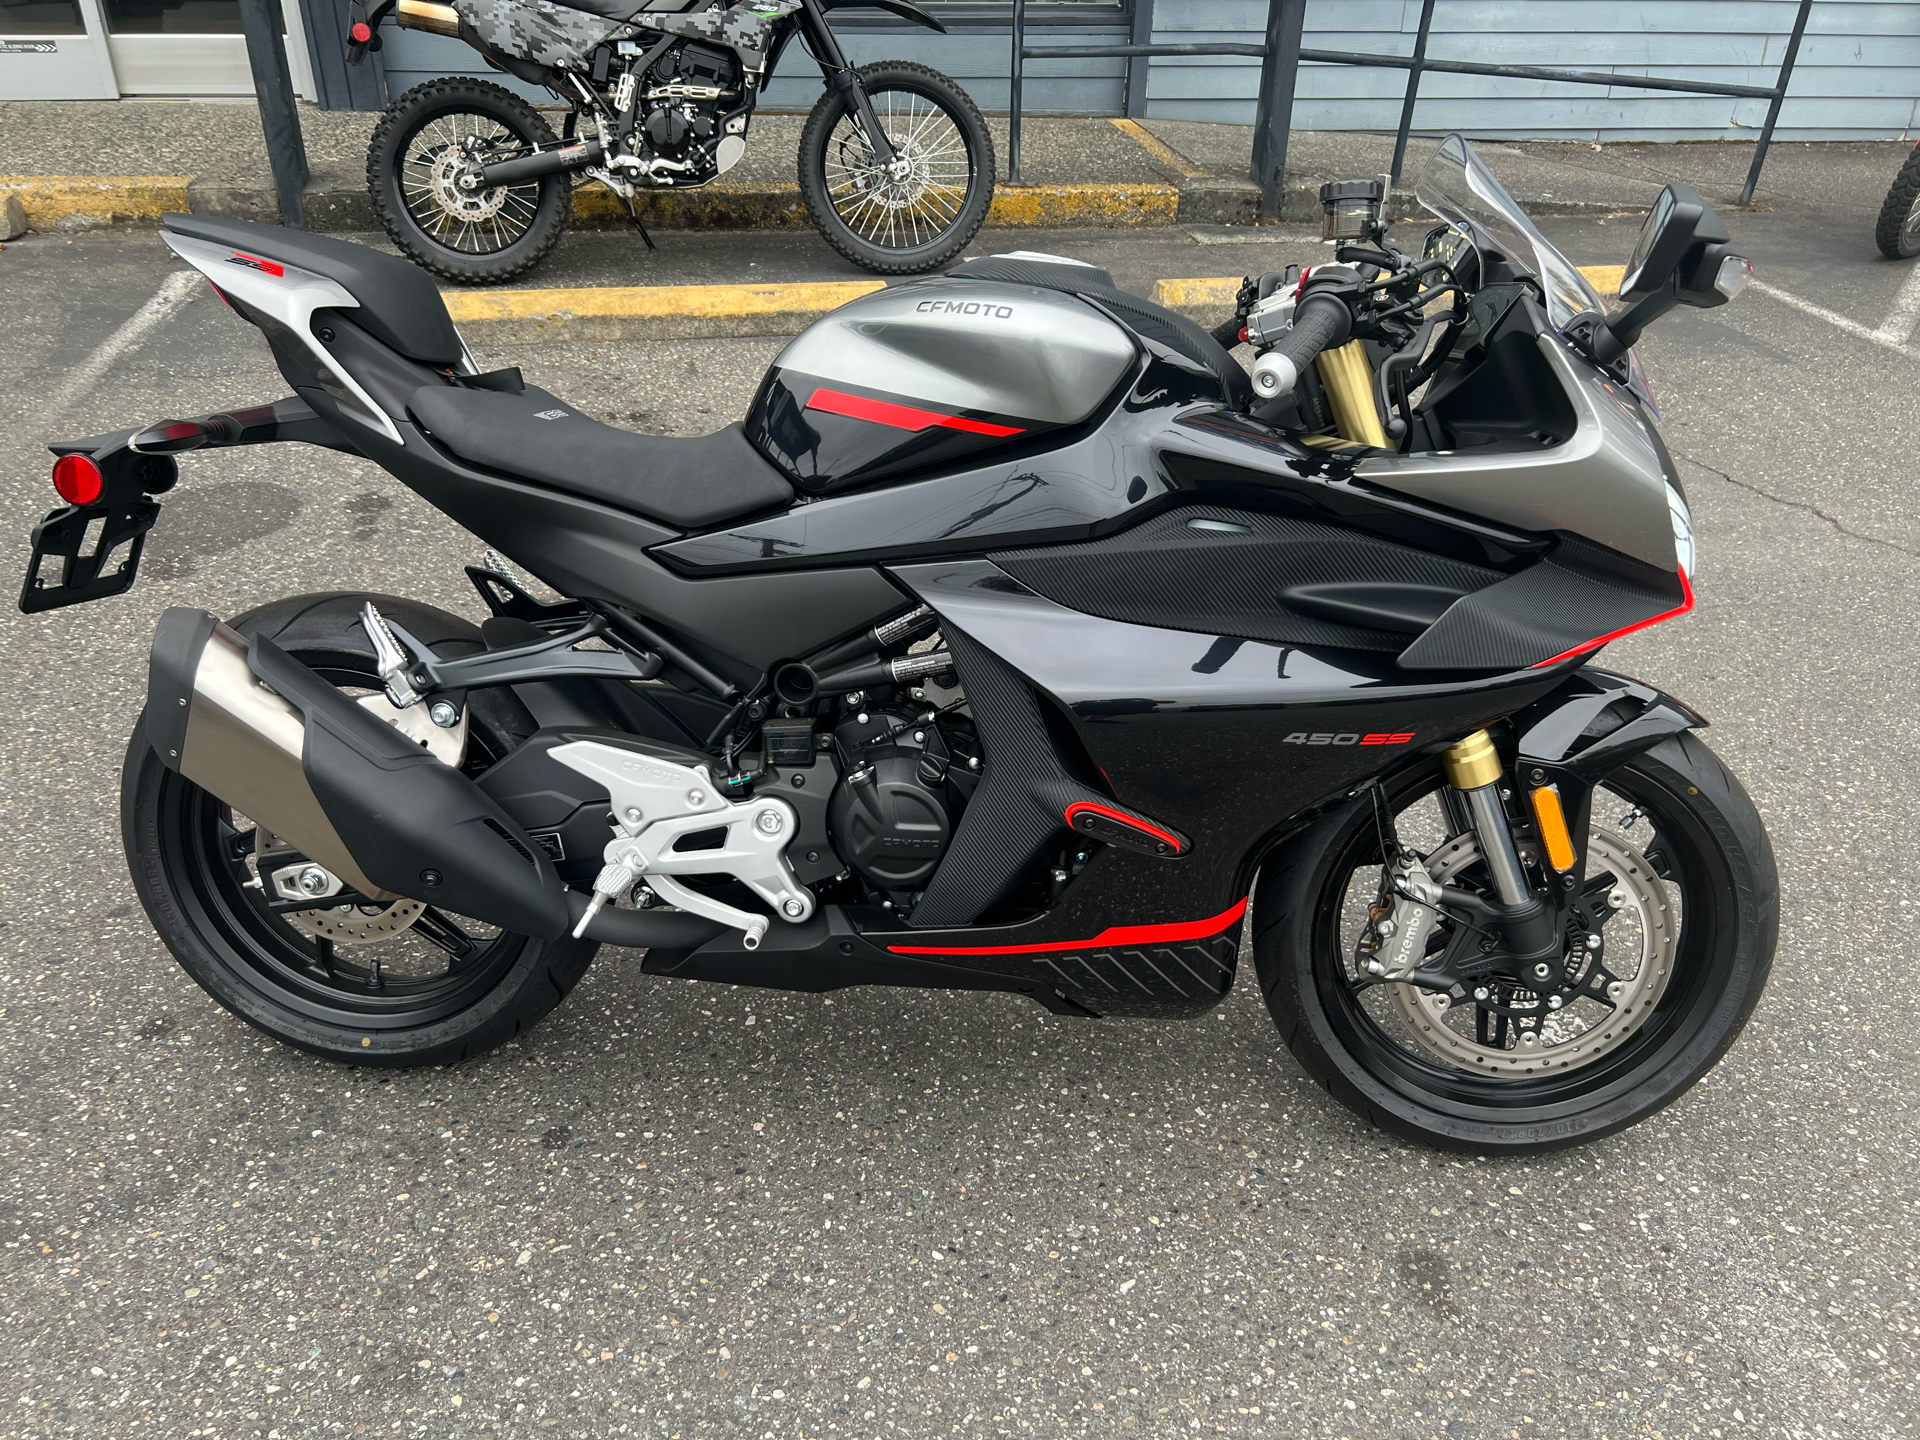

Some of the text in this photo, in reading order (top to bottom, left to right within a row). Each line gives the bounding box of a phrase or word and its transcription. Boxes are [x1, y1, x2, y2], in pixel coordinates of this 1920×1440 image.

[916, 301, 1013, 319] CFMOTO
[621, 760, 681, 782] CFMOTO
[883, 837, 940, 849] CFMOTO
[1394, 908, 1423, 964] brembo
